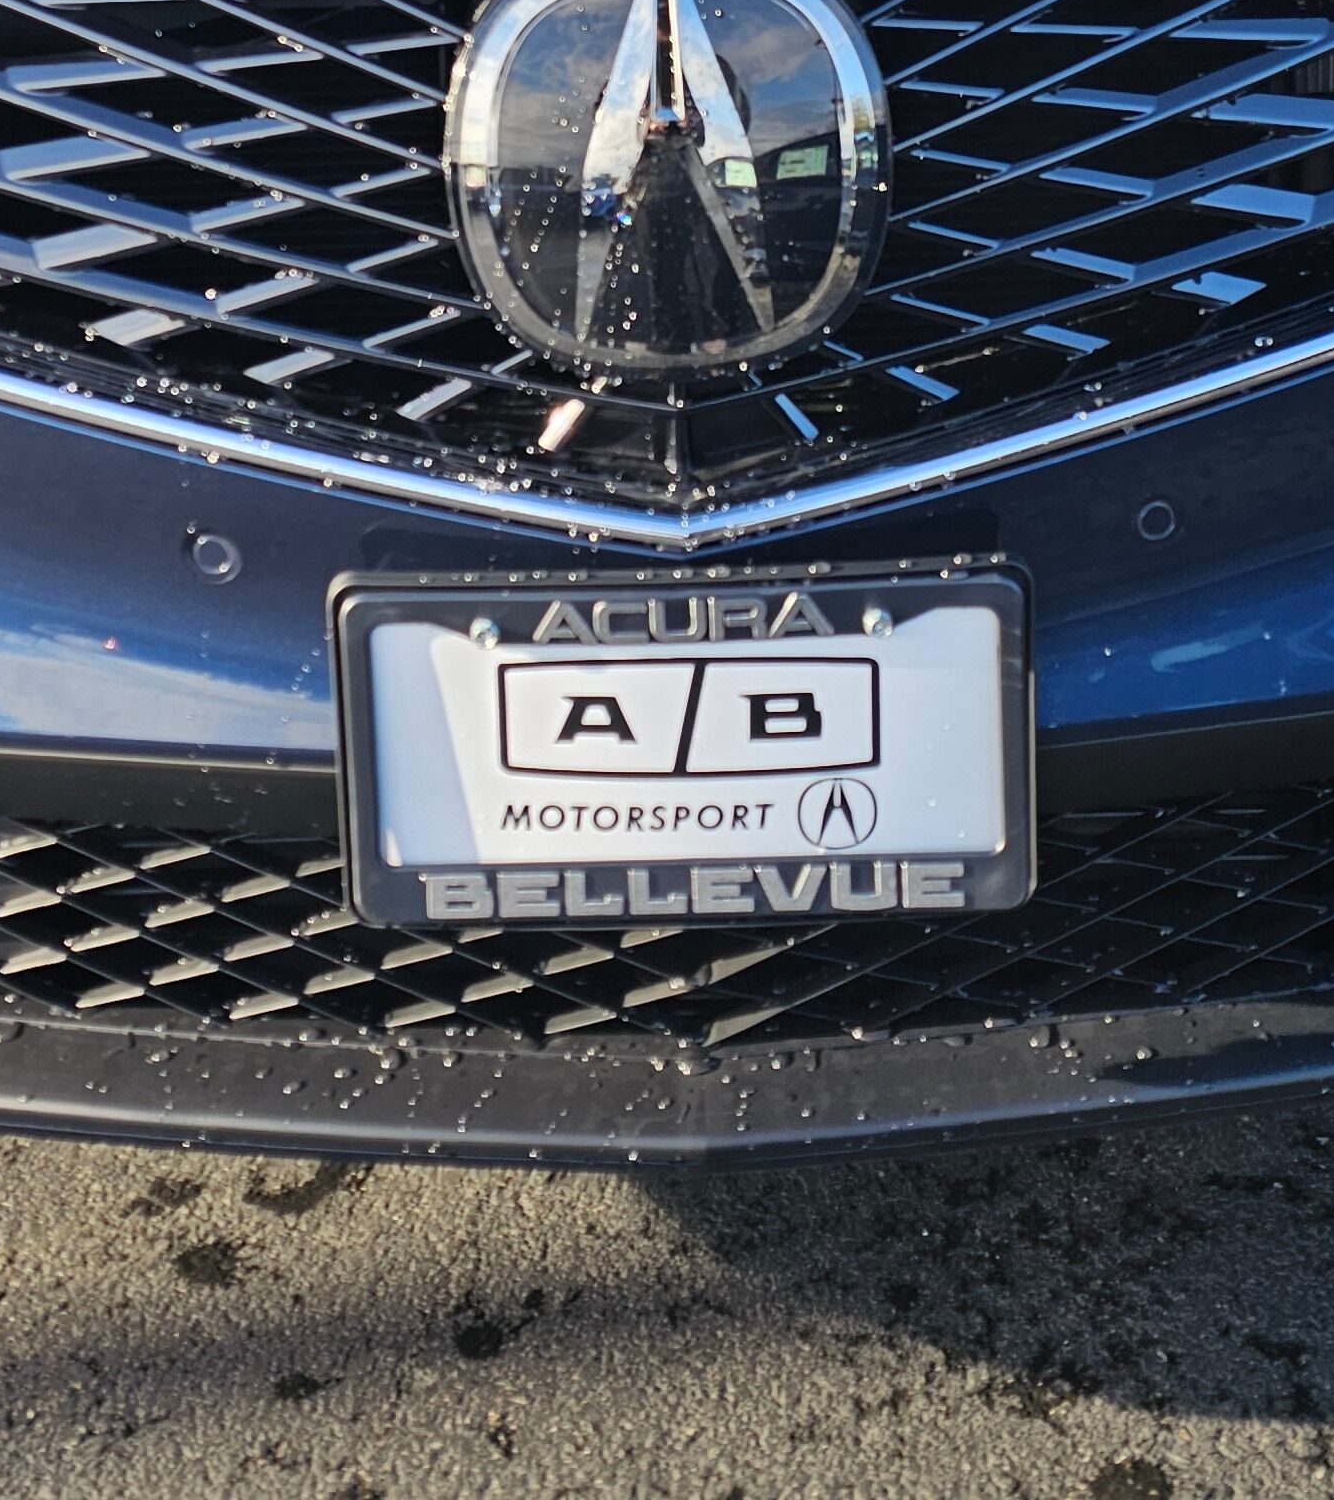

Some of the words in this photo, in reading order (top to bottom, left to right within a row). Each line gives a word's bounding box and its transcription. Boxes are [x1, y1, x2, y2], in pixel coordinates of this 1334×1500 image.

[532, 592, 835, 645] ACURA
[556, 696, 637, 744] A
[740, 692, 822, 741] B
[500, 803, 775, 832] MOTORSPORT
[424, 861, 966, 920] BELLEVUE
